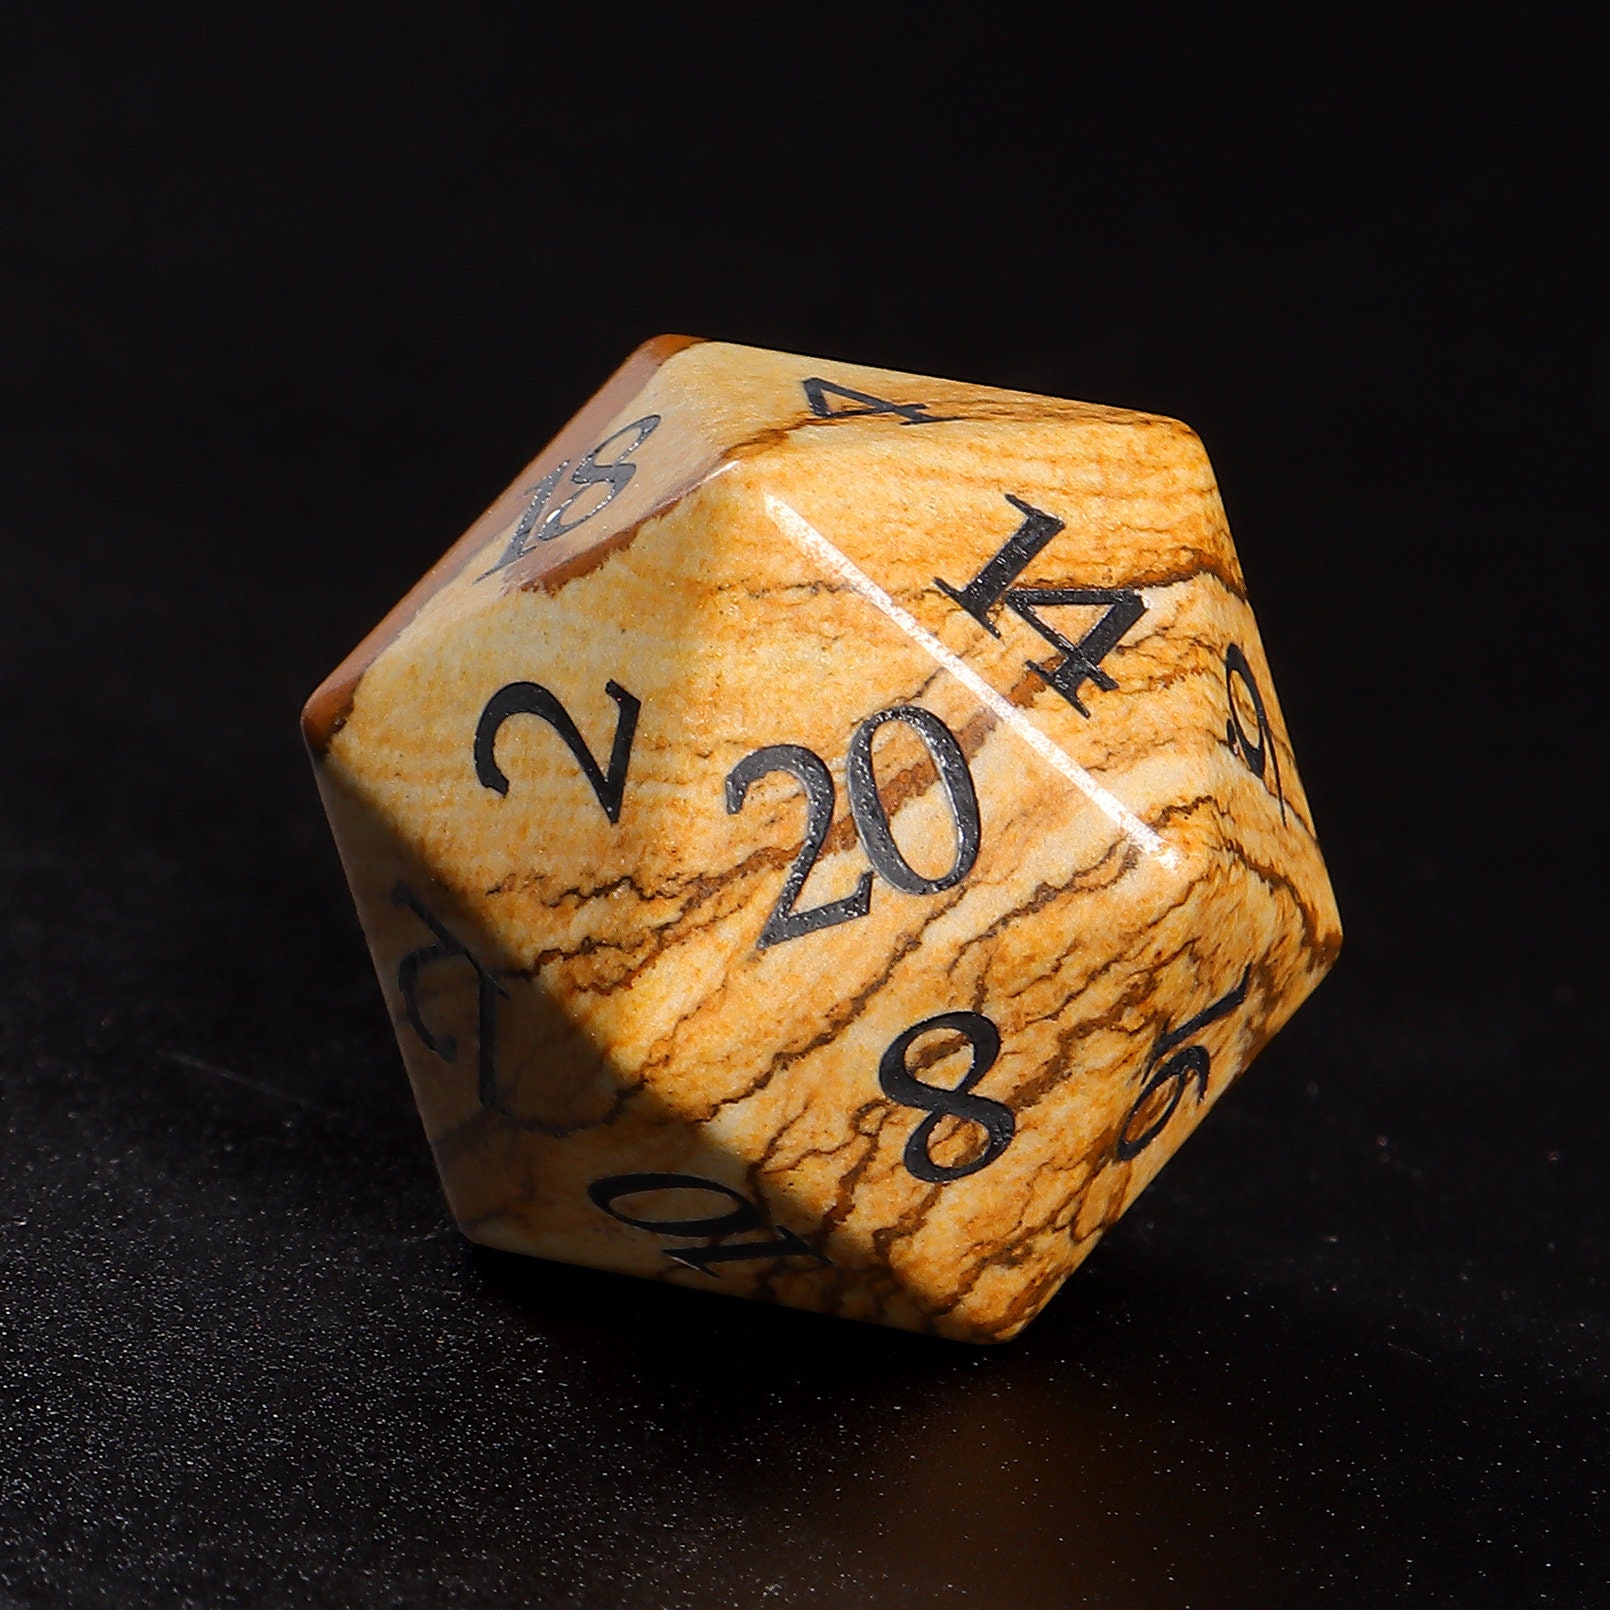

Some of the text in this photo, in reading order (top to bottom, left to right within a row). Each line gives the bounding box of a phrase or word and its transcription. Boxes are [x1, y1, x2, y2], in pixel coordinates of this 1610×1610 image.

[803, 377, 960, 426] 4
[473, 415, 661, 584] 18
[934, 493, 1148, 719] 14
[474, 679, 641, 823] 2
[725, 706, 981, 953] 20
[879, 1011, 1015, 1183] 8
[588, 1173, 834, 1279] 10
